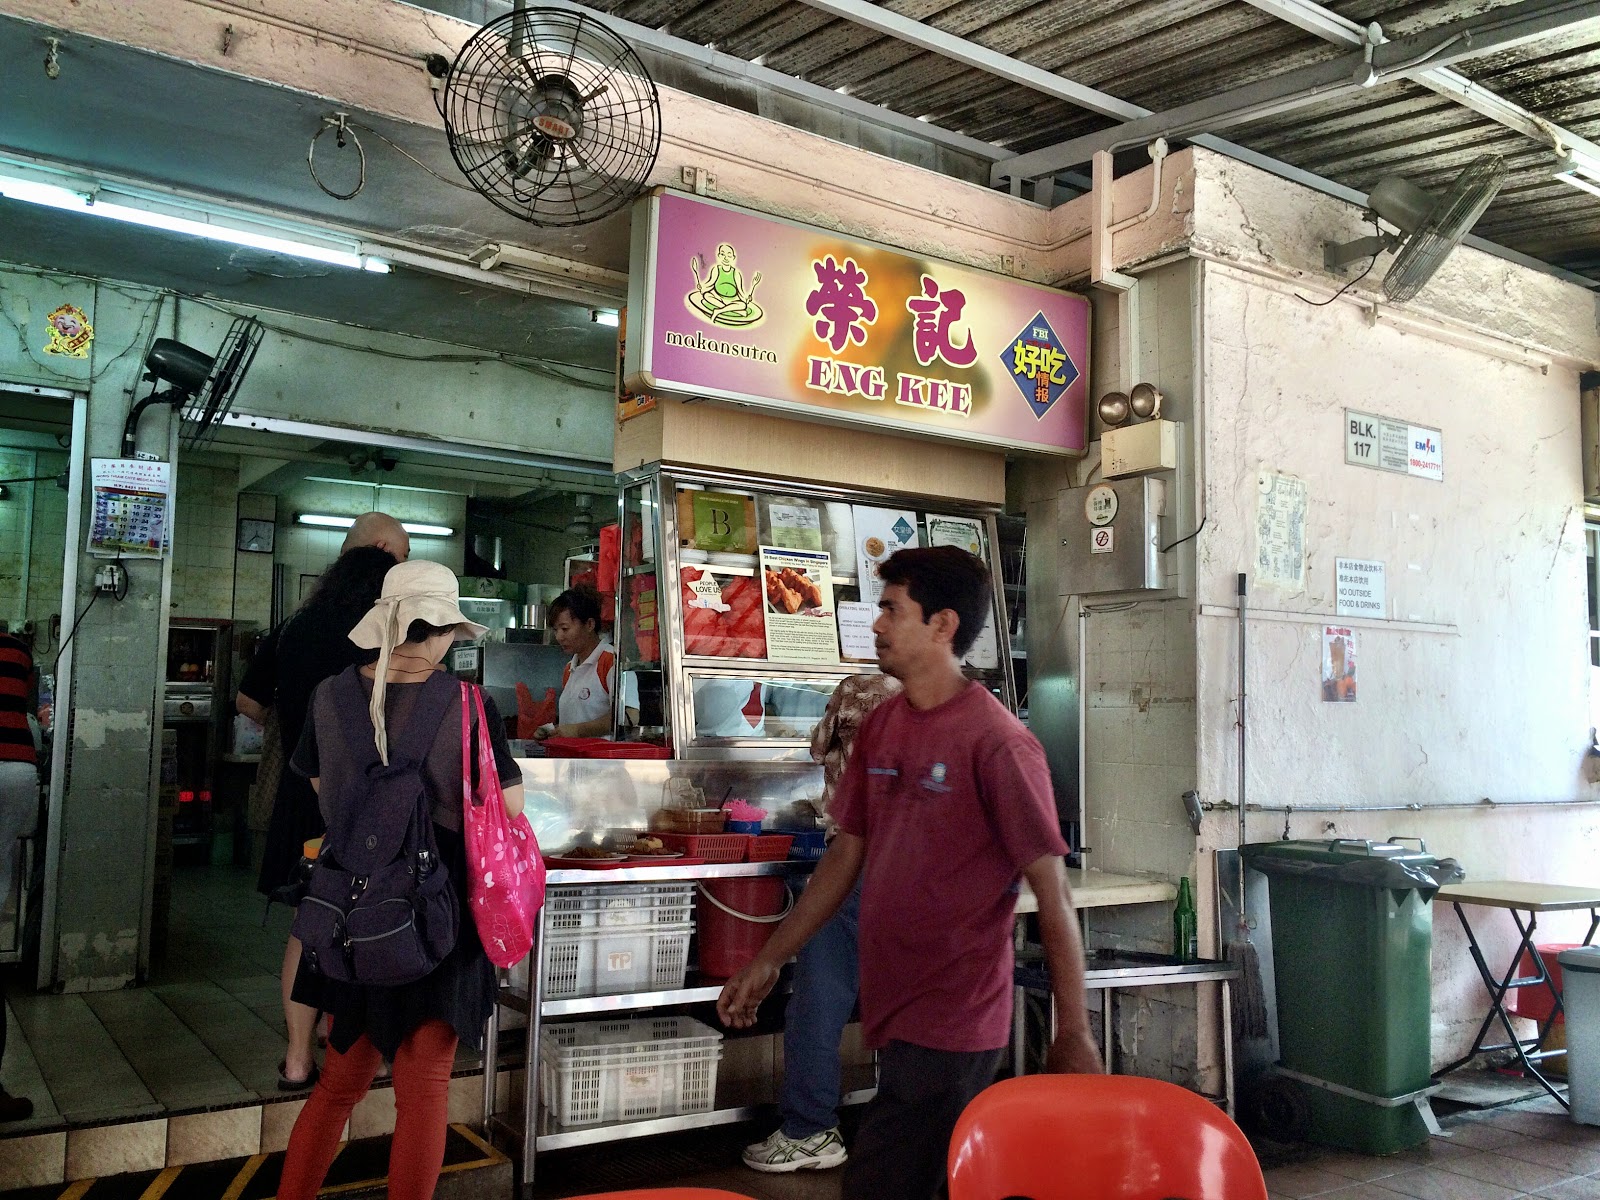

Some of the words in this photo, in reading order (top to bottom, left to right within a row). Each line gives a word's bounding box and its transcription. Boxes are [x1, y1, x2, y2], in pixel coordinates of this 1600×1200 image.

[1032, 327, 1049, 340] FBI
[666, 331, 778, 363] makansutra
[1013, 339, 1067, 385] 好吃
[808, 358, 886, 398] ENG
[899, 375, 972, 415] KEE
[1350, 420, 1376, 439] BLK.
[1353, 441, 1371, 458] 117
[709, 507, 731, 536] B
[1339, 588, 1347, 596] NO
[1348, 588, 1372, 598] OUTSIDE
[1339, 599, 1355, 608] FOOD
[1356, 600, 1360, 608] &
[1360, 600, 1381, 610] DRINKS
